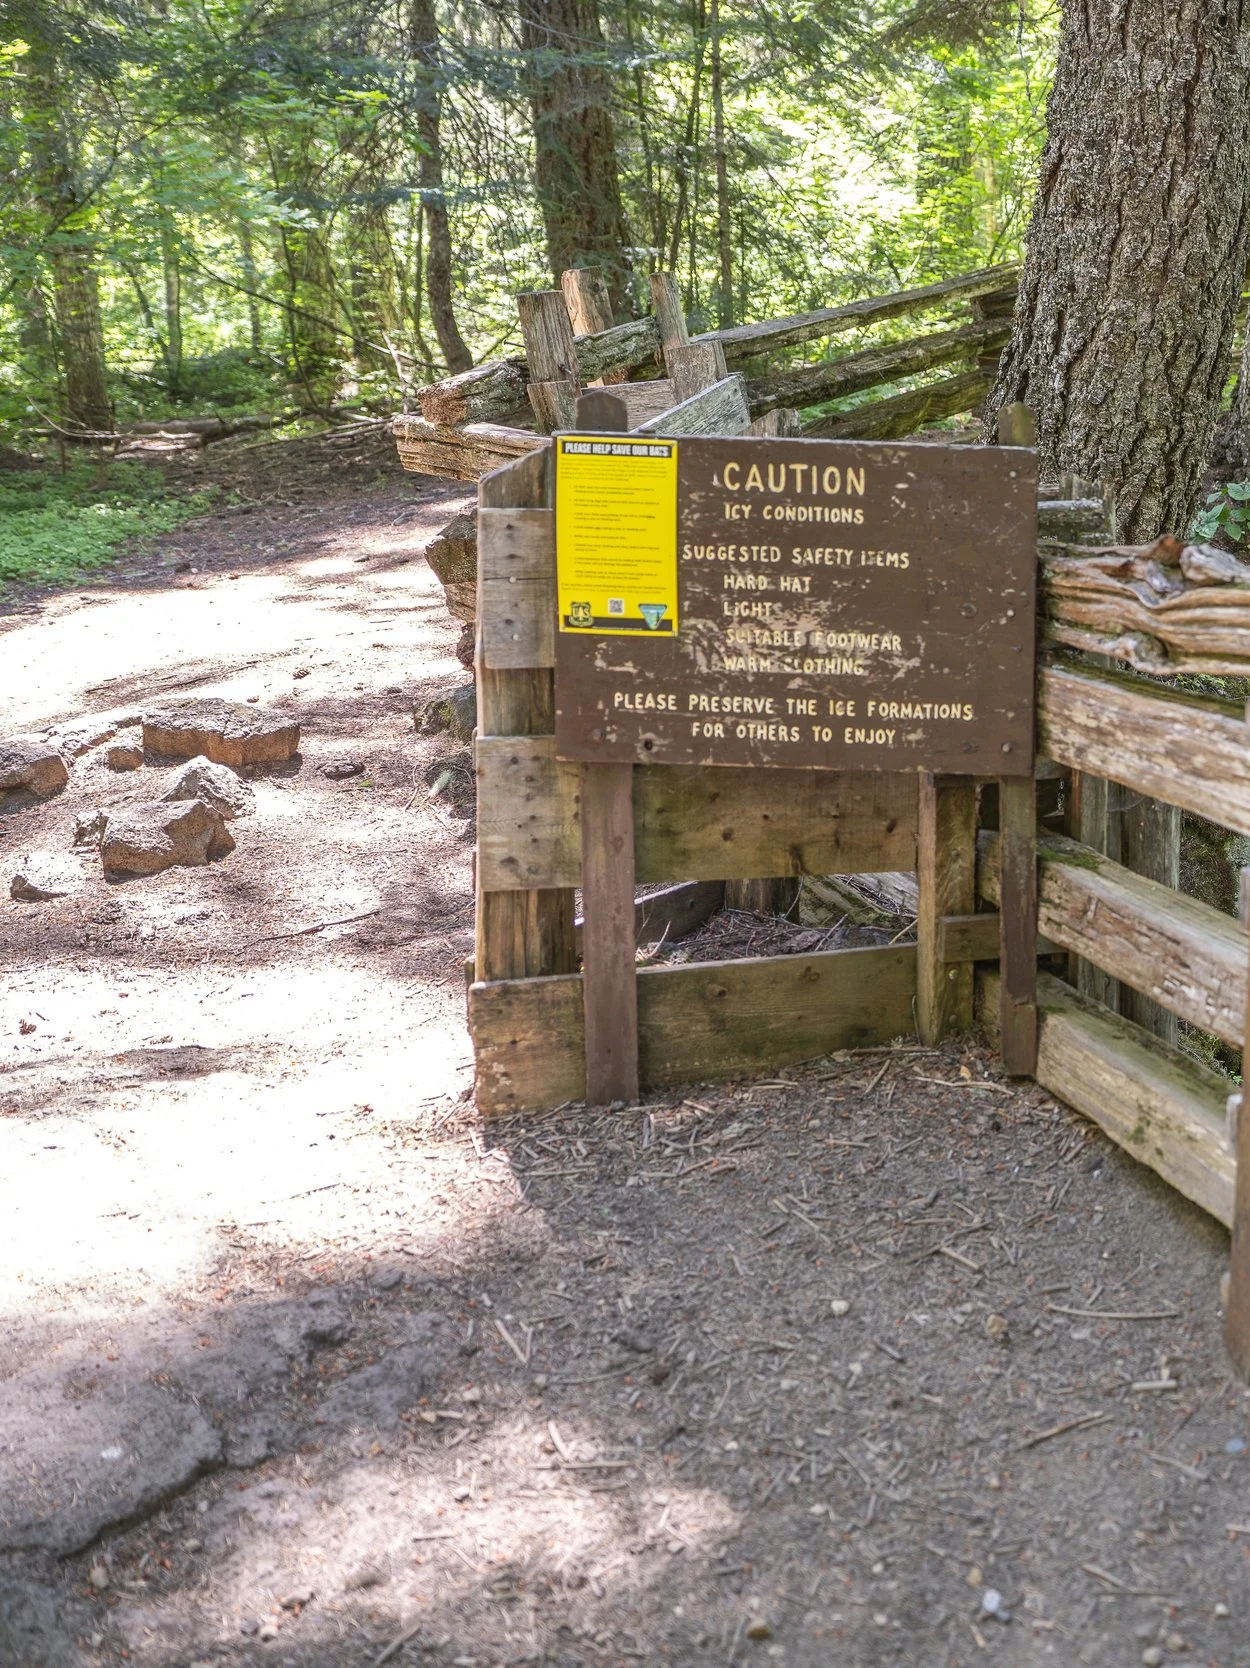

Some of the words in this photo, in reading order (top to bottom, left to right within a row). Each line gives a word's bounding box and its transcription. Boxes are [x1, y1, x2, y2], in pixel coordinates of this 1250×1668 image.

[565, 442, 591, 454] PLEASE
[592, 443, 611, 454] HELP
[612, 444, 631, 456] SAVE
[631, 445, 648, 456] OUR
[723, 462, 866, 496] CAUTION
[724, 504, 751, 520] ICY
[763, 505, 864, 525] CONDITIONS
[682, 544, 781, 562] SUGGESTED
[791, 547, 853, 565] SAFETY
[723, 574, 767, 590] HARD
[780, 576, 811, 593] HAT
[726, 628, 802, 647] SUITABLE
[814, 631, 902, 651] FOOTWEAR
[723, 656, 771, 673] WARM
[784, 657, 865, 676] CLOTHING
[614, 692, 677, 711] PLEASE
[688, 694, 775, 714] PRESERVE
[786, 698, 817, 716] THE
[829, 699, 856, 717] ICE
[867, 701, 974, 721] FORMATIONS
[692, 723, 724, 739] FOR
[736, 724, 800, 742] OTHERS
[812, 726, 832, 742] TO
[844, 727, 896, 745] ENJOY
